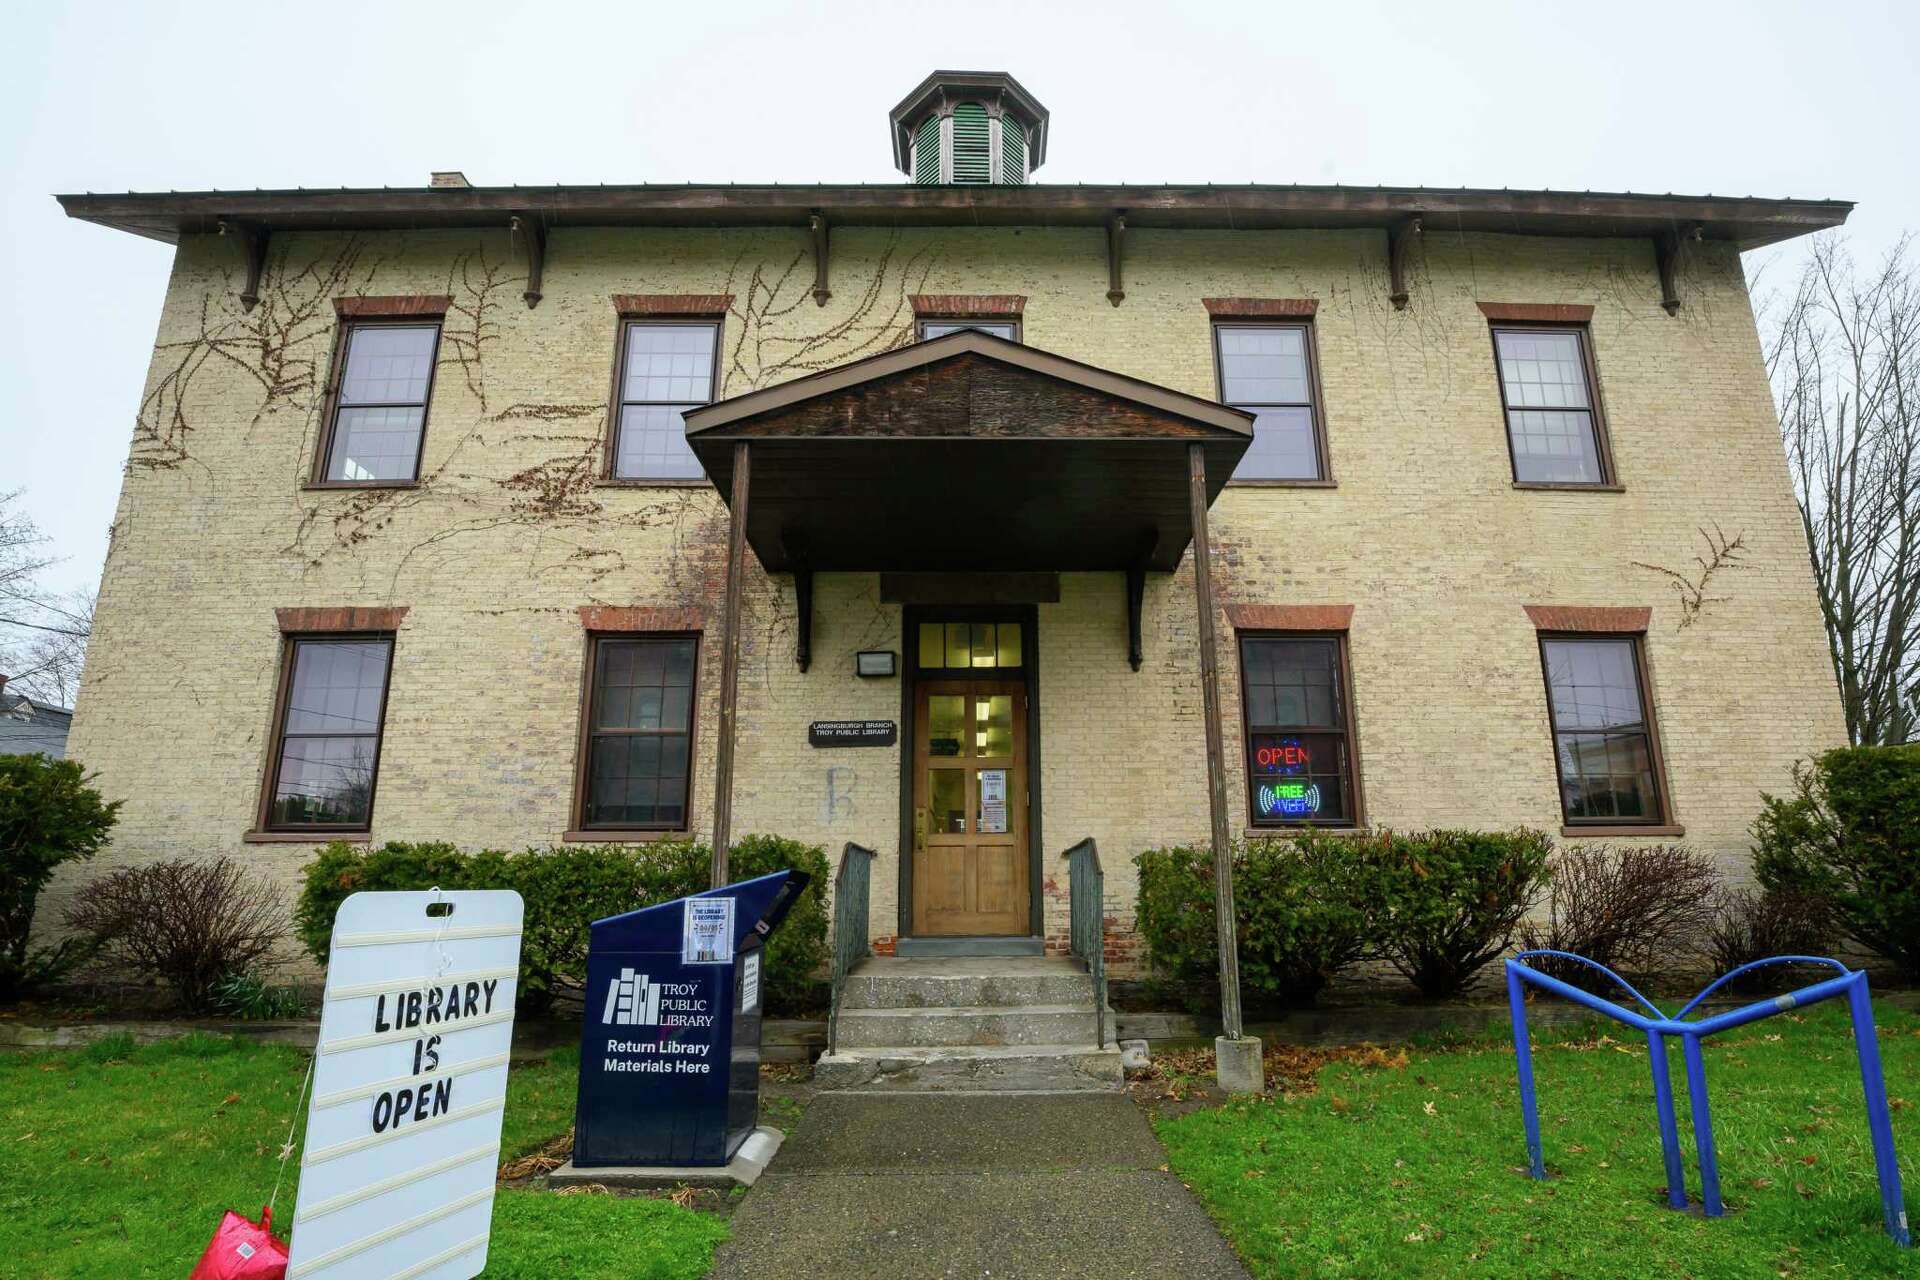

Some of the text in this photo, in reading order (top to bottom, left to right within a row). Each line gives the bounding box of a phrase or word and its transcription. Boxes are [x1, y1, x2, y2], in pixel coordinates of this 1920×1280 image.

[865, 721, 893, 729] BRANCH
[1257, 746, 1312, 765] OPEN
[1275, 785, 1305, 798] FREE
[662, 983, 698, 996] TROY
[375, 979, 498, 1033] LIBRARY
[661, 999, 707, 1011] PUBLIC
[659, 1014, 714, 1027] LIBRARY
[413, 1035, 441, 1075] IS
[607, 1039, 710, 1056] Return Library
[604, 1058, 711, 1073] Materials Here
[373, 1077, 452, 1133] OPEN
